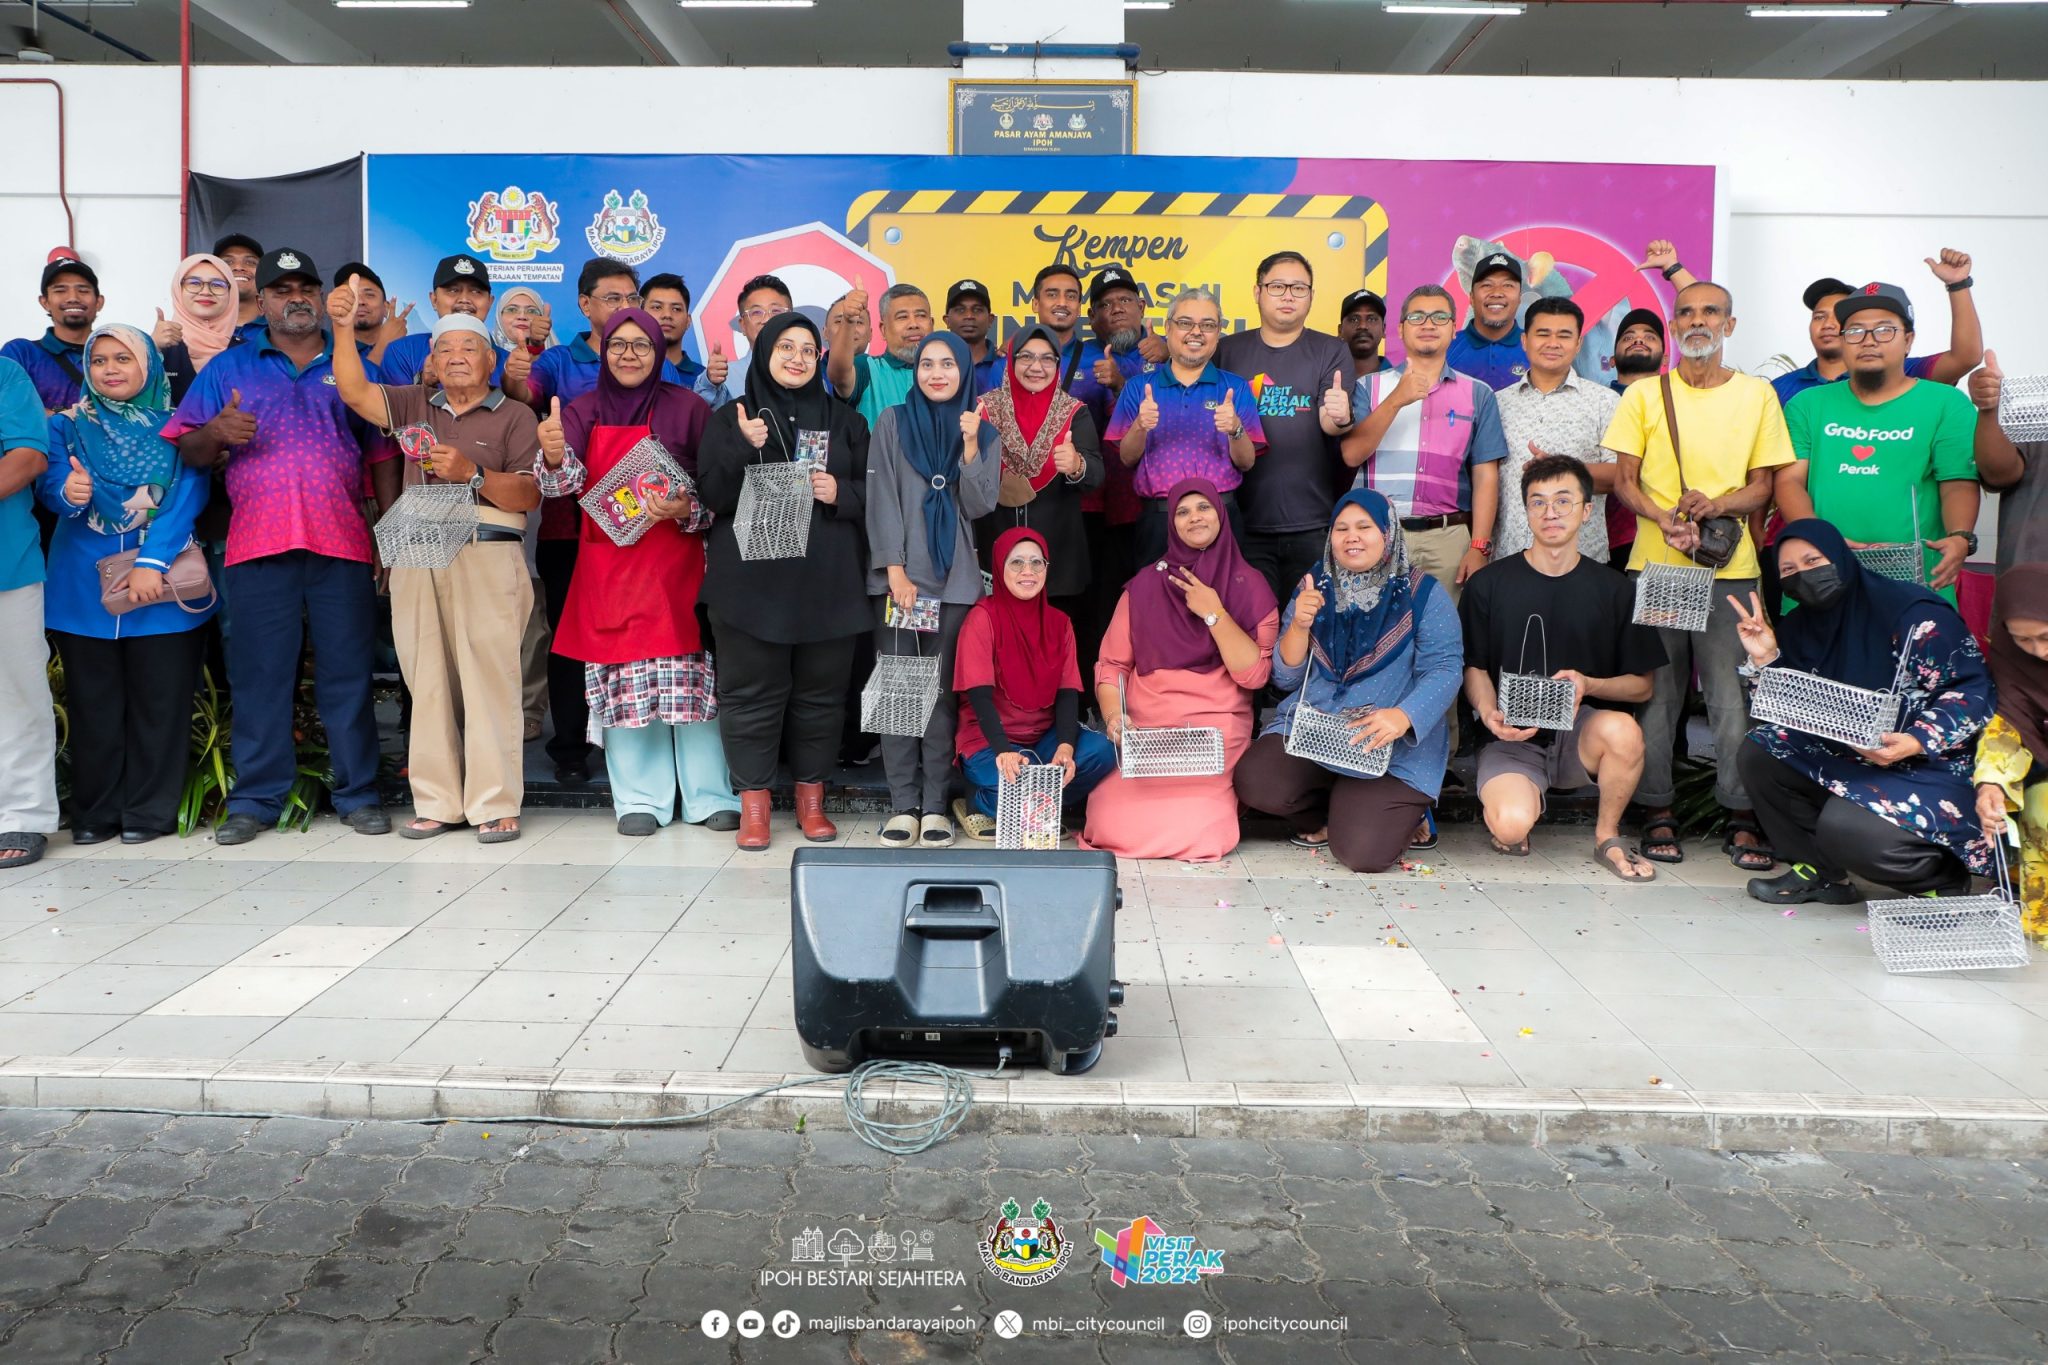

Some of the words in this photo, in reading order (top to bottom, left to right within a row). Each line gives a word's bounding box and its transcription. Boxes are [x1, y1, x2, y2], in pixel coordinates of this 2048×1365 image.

[994, 130, 1021, 139] PASAR
[1023, 130, 1047, 139] AYAM
[1049, 131, 1092, 140] AMANJAYA
[587, 228, 606, 256] MAJLIS
[606, 248, 654, 264] BANDARAYA
[652, 228, 664, 249] IPOH
[1034, 224, 1188, 278] Kempen
[1264, 386, 1292, 396] VISIT
[1260, 395, 1311, 408] PERAK
[1259, 405, 1295, 417] 2024
[1838, 463, 1880, 475] Perak
